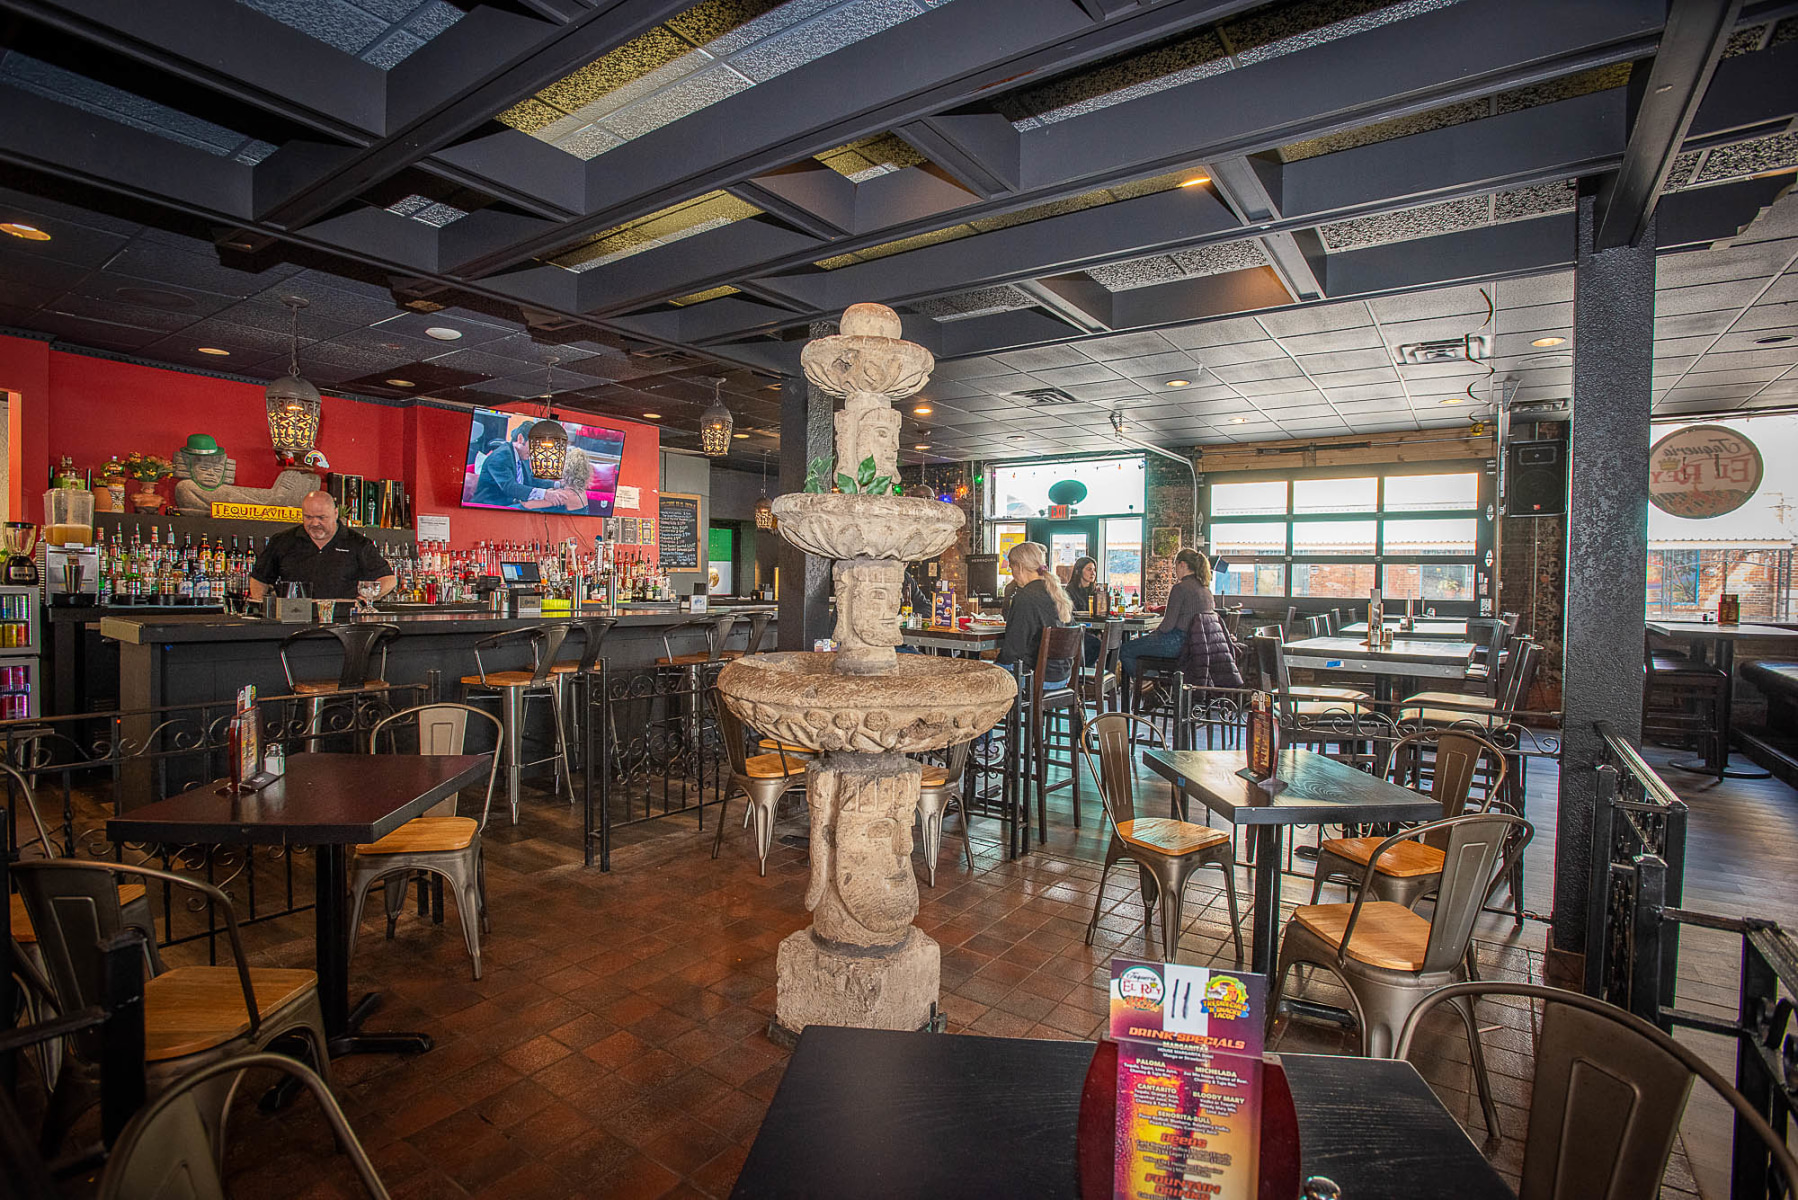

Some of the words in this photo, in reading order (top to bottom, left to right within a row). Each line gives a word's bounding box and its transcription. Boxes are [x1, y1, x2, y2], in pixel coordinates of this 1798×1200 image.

[214, 503, 302, 519] TEQUILAVILLE
[1051, 505, 1067, 519] EXIT
[1129, 1026, 1174, 1040] DRINK
[1176, 1033, 1246, 1049] SPECIALS
[1136, 1058, 1166, 1068] PALOMA
[1194, 1066, 1237, 1077] MICHELADA
[1137, 1083, 1177, 1094] CANTARITO
[1193, 1091, 1222, 1101] BLOODY
[1223, 1095, 1245, 1105] MARY
[1145, 1173, 1221, 1194] FOUNTAIN
